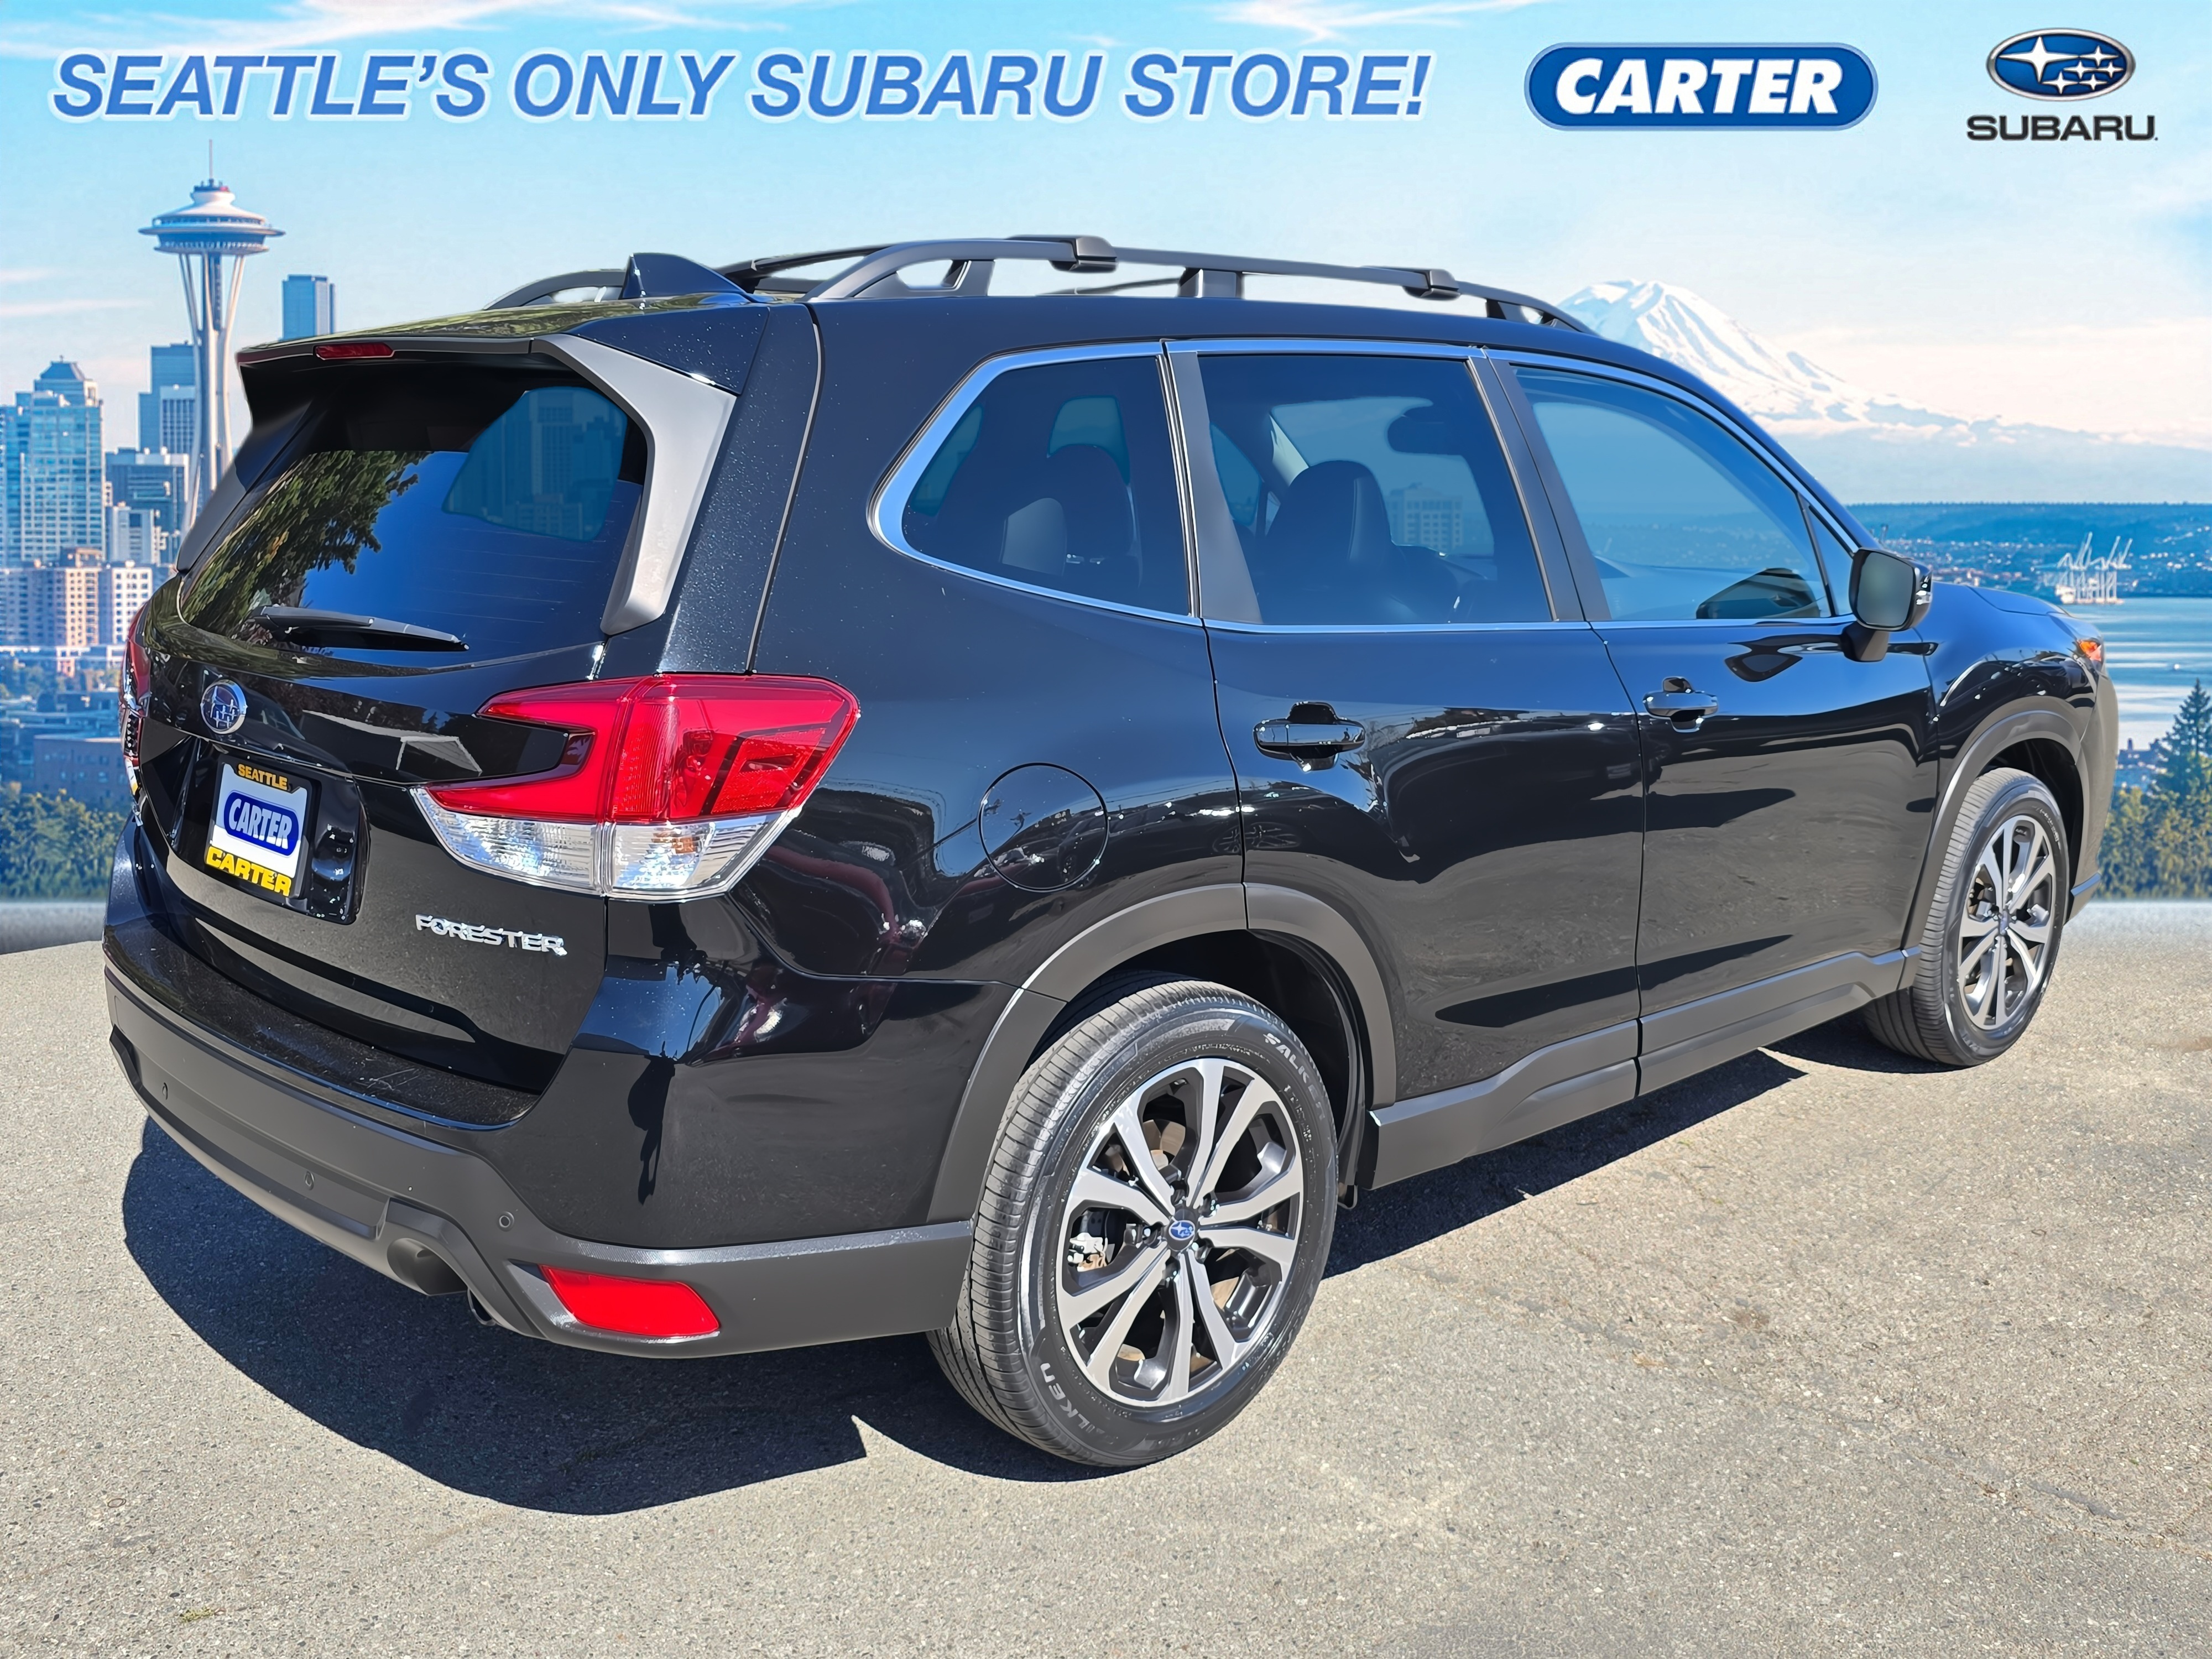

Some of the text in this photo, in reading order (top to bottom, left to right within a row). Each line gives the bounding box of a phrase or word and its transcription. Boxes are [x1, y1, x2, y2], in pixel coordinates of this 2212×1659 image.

[237, 763, 288, 791] SEATTLE
[228, 798, 293, 850] CARTER
[206, 846, 292, 897] CARTER
[415, 914, 568, 956] FORESTER
[1040, 1362, 1116, 1445] ALKEN
